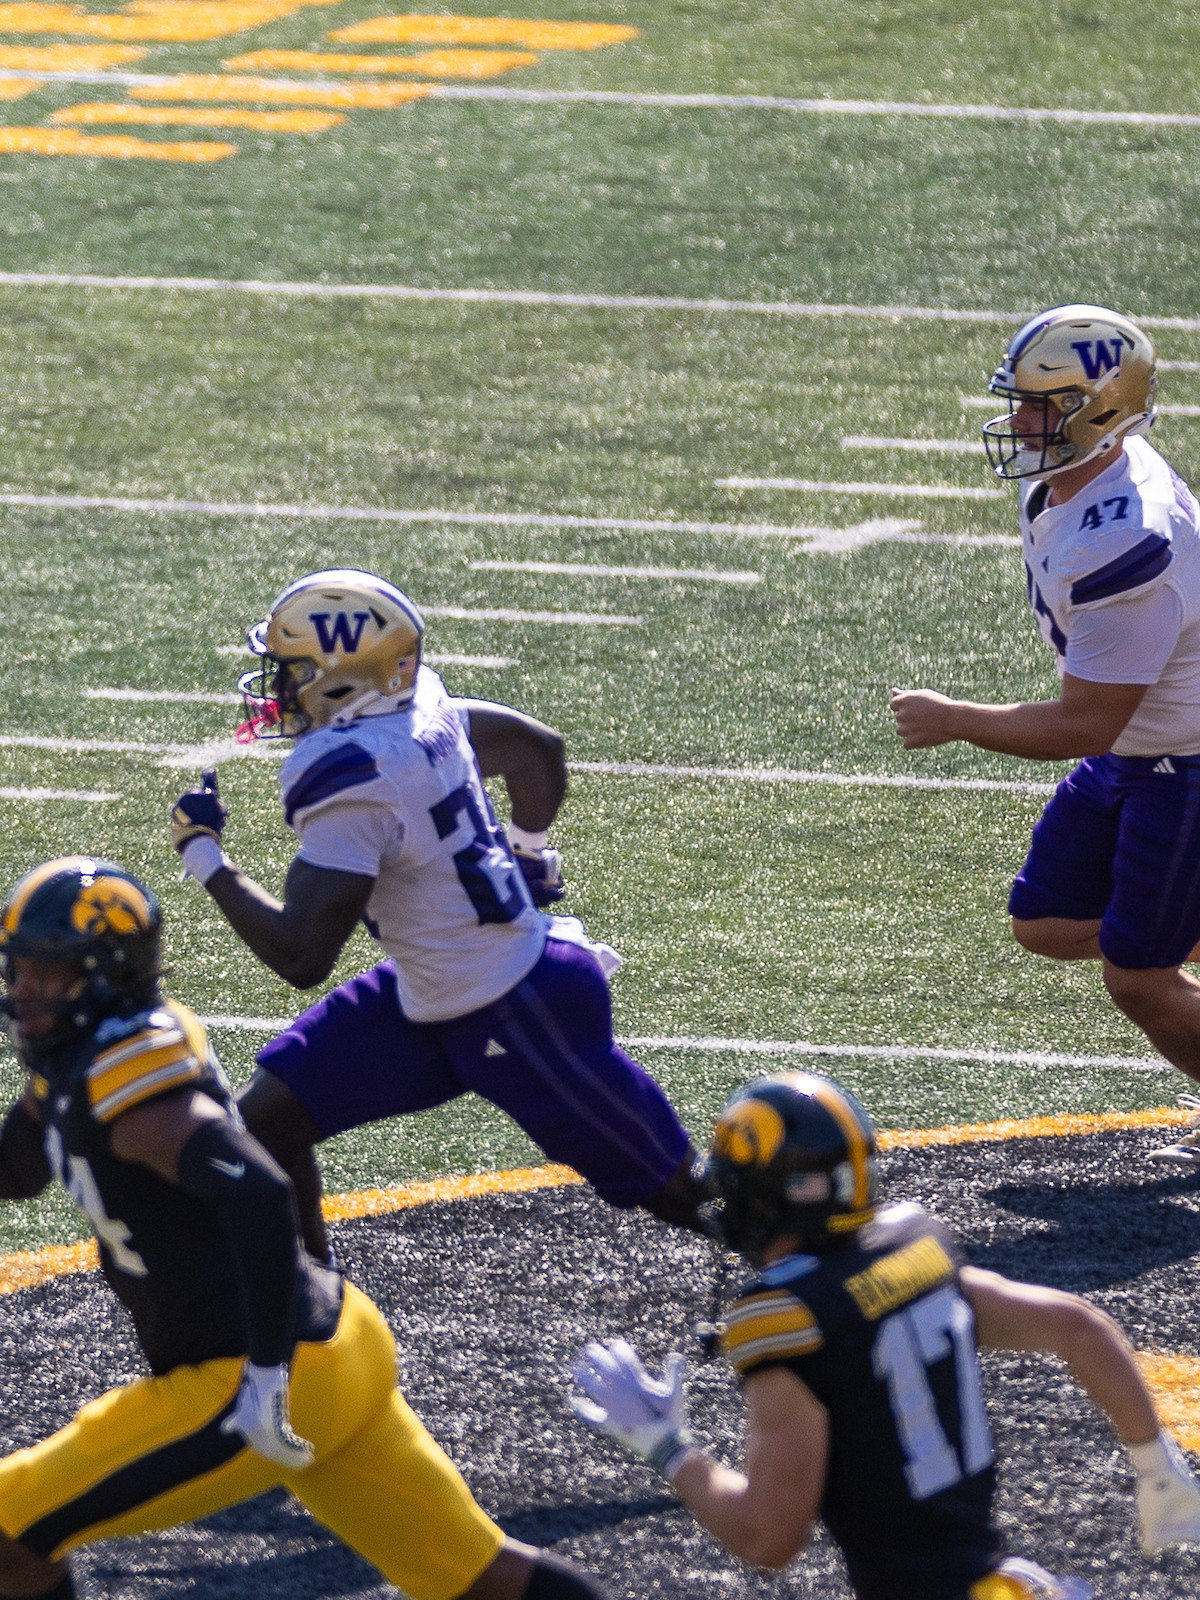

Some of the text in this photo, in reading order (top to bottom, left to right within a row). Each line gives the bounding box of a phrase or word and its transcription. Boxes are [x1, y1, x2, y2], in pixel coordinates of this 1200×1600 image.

[1070, 338, 1125, 380] W
[1078, 496, 1130, 533] 47
[309, 612, 370, 654] W
[871, 1284, 995, 1500] 17
